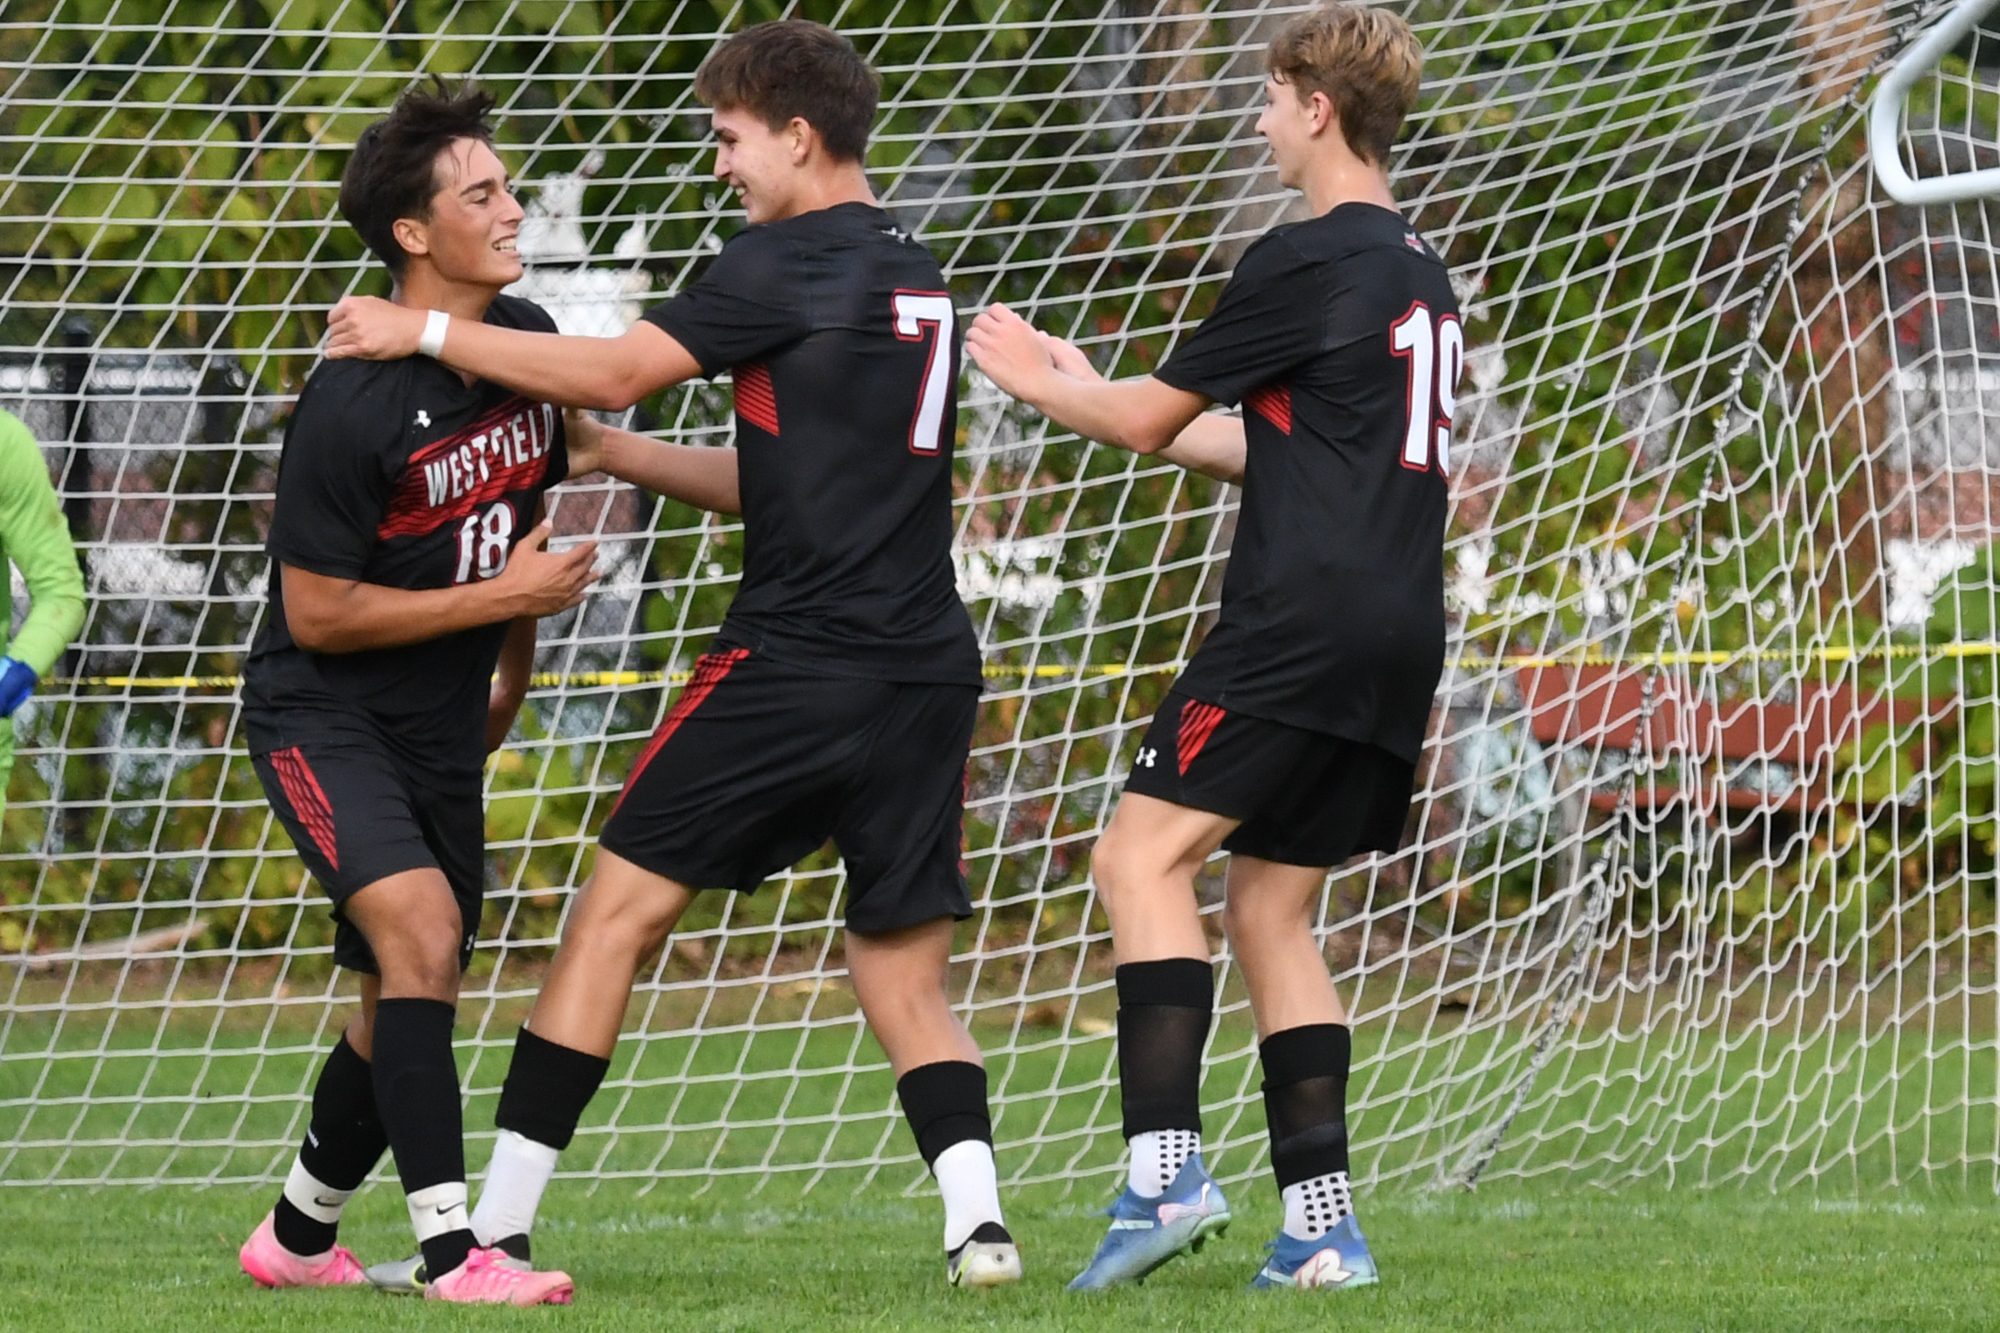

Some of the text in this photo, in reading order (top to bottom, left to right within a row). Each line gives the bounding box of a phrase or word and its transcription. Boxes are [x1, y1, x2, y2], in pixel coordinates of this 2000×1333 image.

[891, 288, 954, 456] 7
[1389, 300, 1464, 481] 19
[423, 402, 554, 508] WESTFIELD
[452, 500, 516, 585] 18
